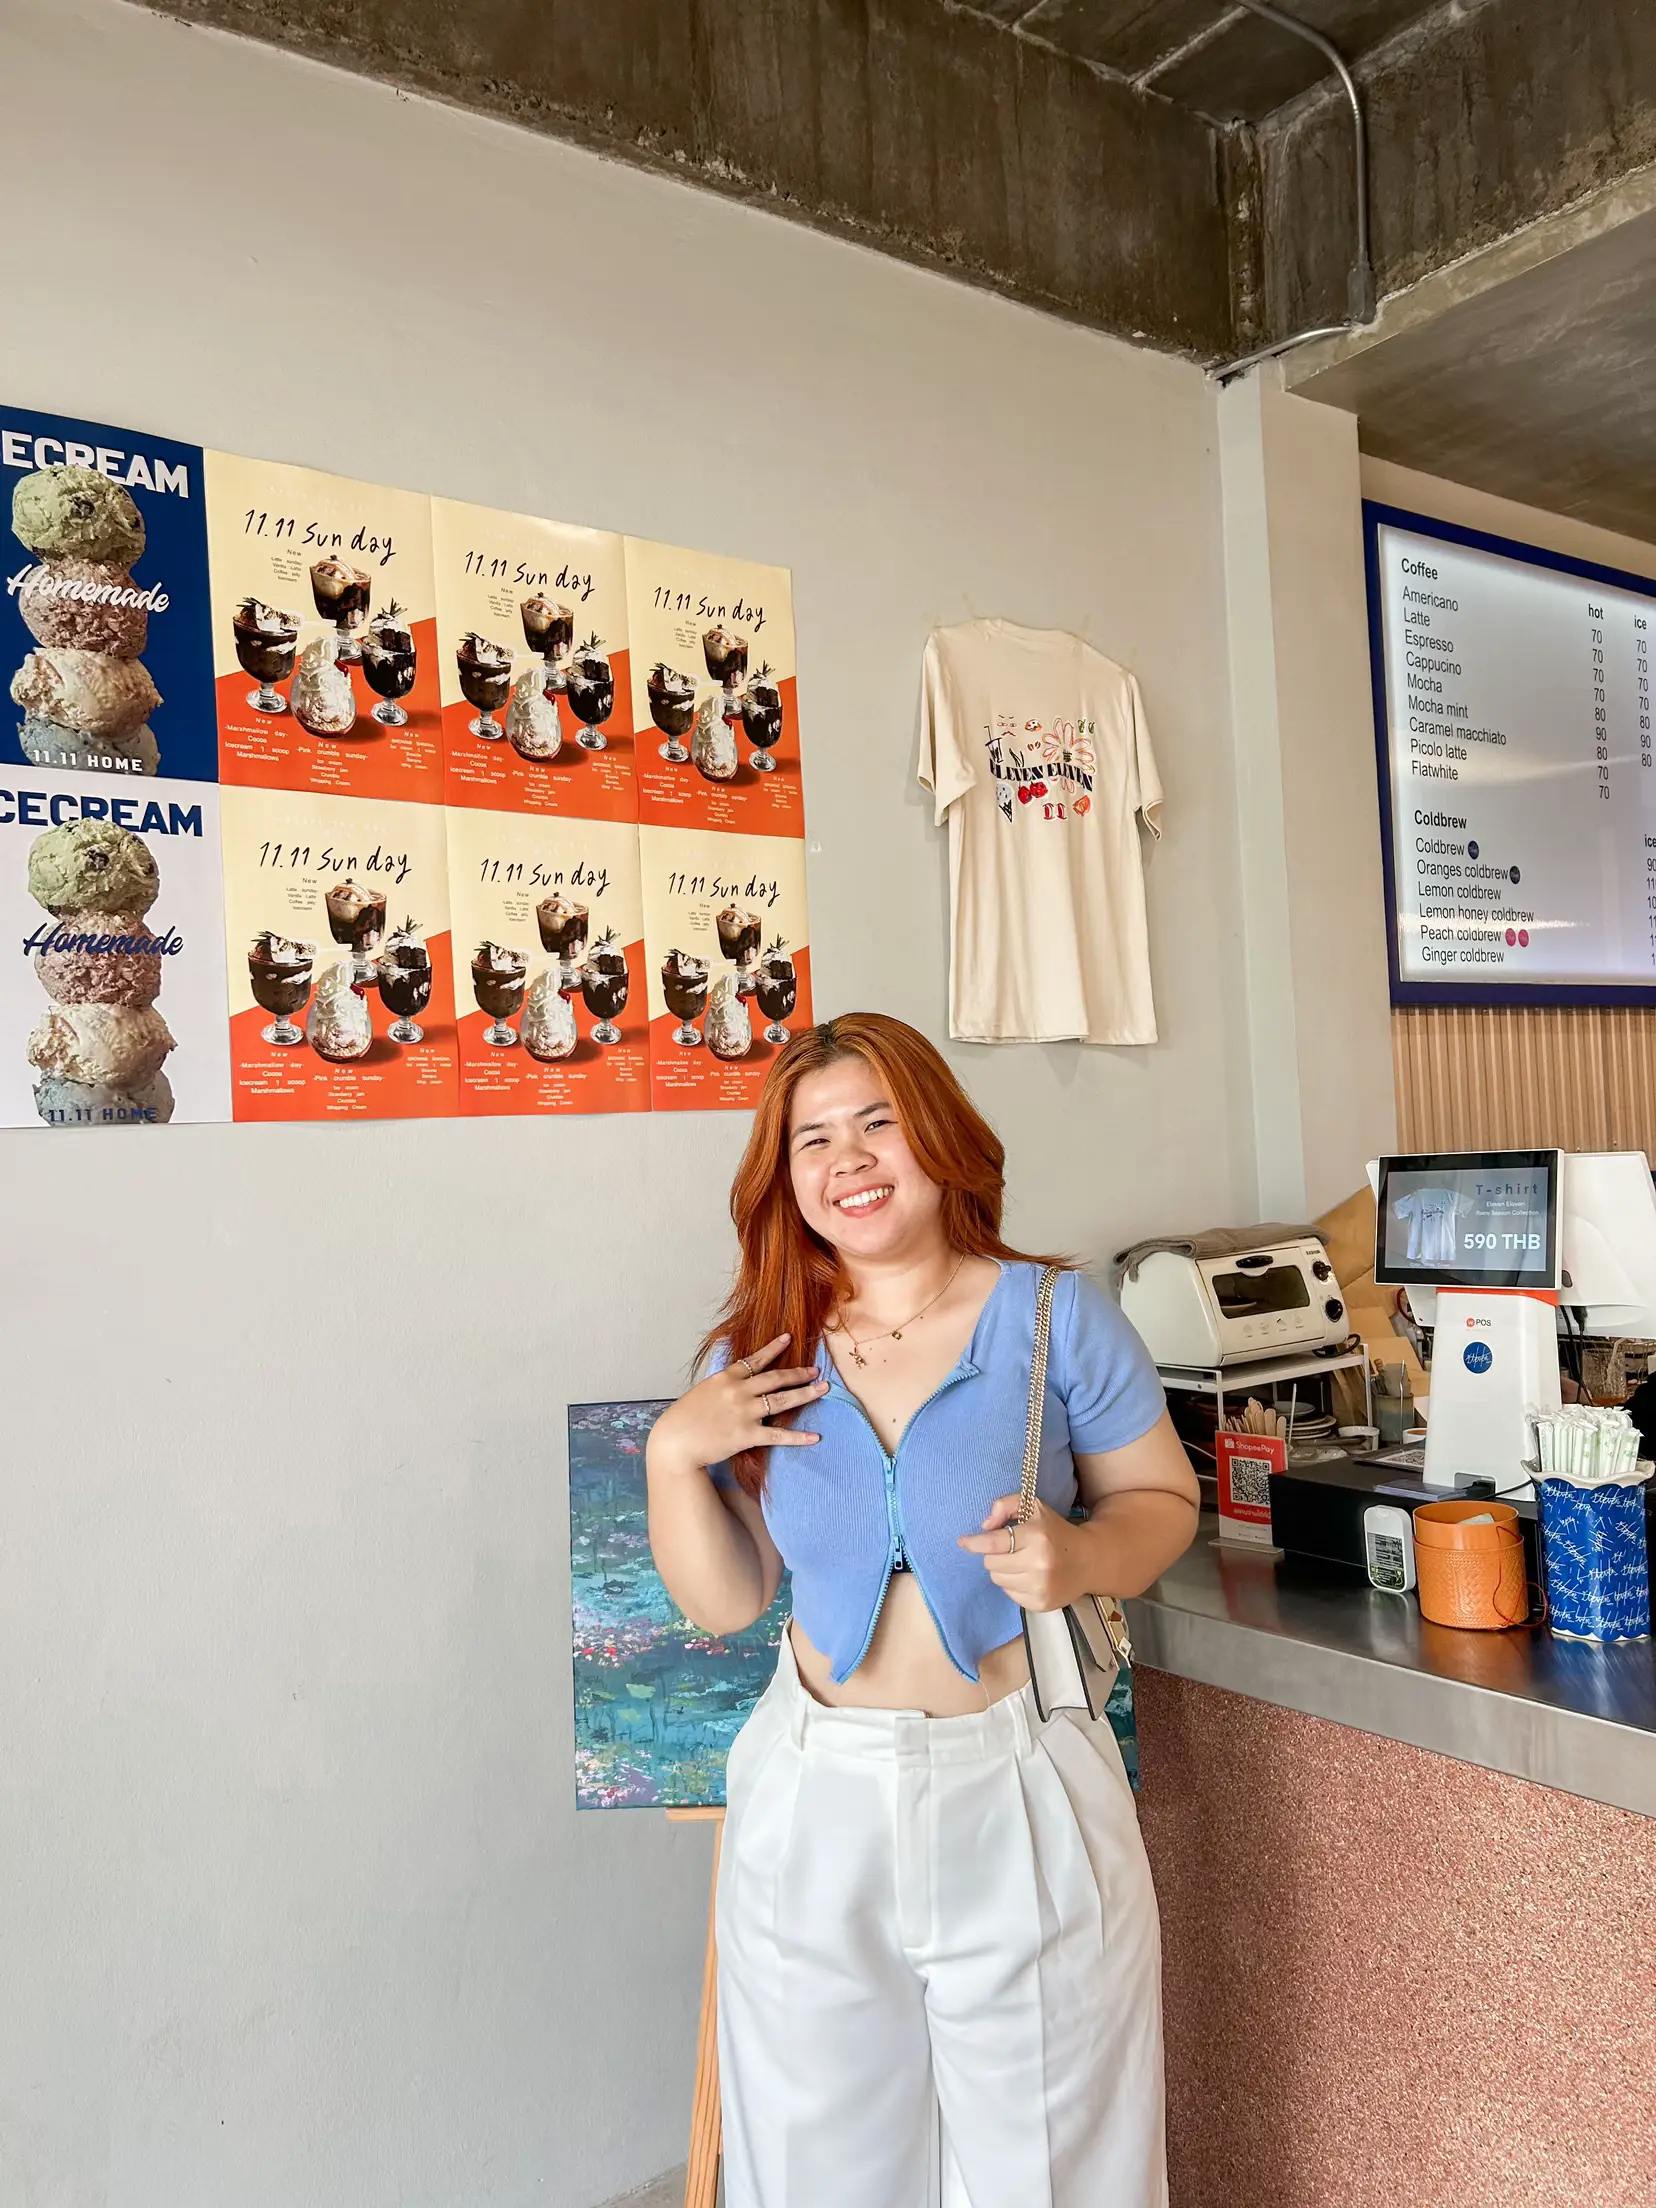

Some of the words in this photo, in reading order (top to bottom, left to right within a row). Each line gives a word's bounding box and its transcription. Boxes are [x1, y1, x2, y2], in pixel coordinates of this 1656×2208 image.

[245, 510, 295, 538] 11.11
[465, 551, 507, 577] 11.11
[1402, 558, 1438, 580] Coffee
[7, 563, 169, 612] Homemade
[1403, 586, 1458, 611] Americano
[655, 587, 691, 611] 11.11
[1404, 607, 1430, 627] Latte
[1588, 604, 1604, 620] hot
[1634, 615, 1647, 629] ice
[1405, 629, 1454, 652] Espresso
[1592, 629, 1602, 643] 70
[1637, 640, 1646, 653] 70
[1406, 652, 1462, 675] Cappucino
[1593, 649, 1603, 663] 70
[1637, 659, 1647, 672] 70
[1407, 673, 1443, 693] Mocha
[1593, 669, 1604, 683] 70
[1638, 678, 1648, 691] 70
[1409, 695, 1443, 715] Mocha
[1447, 703, 1468, 719] mint
[1594, 688, 1605, 702] 70
[1639, 697, 1649, 710] 70
[1595, 708, 1606, 722] 80
[1640, 716, 1650, 730] 80
[1410, 717, 1453, 737] Caramel
[1457, 727, 1507, 745] macchiato
[1596, 727, 1606, 741] 90
[1641, 735, 1651, 748] 90
[1411, 739, 1443, 757] Picolo
[1446, 745, 1467, 760] latte
[1597, 747, 1607, 760] 80
[1641, 753, 1651, 767] 80
[34, 750, 76, 765] 11.11
[88, 755, 143, 772] HOME
[1412, 760, 1458, 780] Flatwhite
[1598, 766, 1608, 780] 70
[1599, 786, 1609, 799] 70
[1415, 810, 1467, 829] Coldbrew
[260, 842, 310, 868] 11.11
[1416, 838, 1464, 856] Coldbrew
[481, 859, 523, 882] 11.11
[1417, 859, 1461, 879] Oranges
[1465, 864, 1508, 880] coldbrew
[669, 873, 705, 895] 11.11
[1418, 881, 1453, 898] Lemon
[1457, 885, 1501, 900] coldbrew
[1420, 903, 1455, 919] Lemon
[1459, 906, 1488, 923] honey
[1492, 908, 1534, 922] coldbrew
[23, 923, 184, 956] Homemade
[1421, 925, 1454, 940] Peach
[1457, 928, 1501, 943] coldbrew
[1422, 947, 1457, 965] Ginger
[1460, 949, 1504, 963] coldbrew
[49, 1108, 92, 1122] 11.11
[103, 1107, 157, 1122] HOME
[1476, 1184, 1537, 1195] T-shirt
[1464, 1233, 1496, 1250] 590
[1502, 1233, 1540, 1250] THB
[1236, 1441, 1275, 1455] ShopeePay
